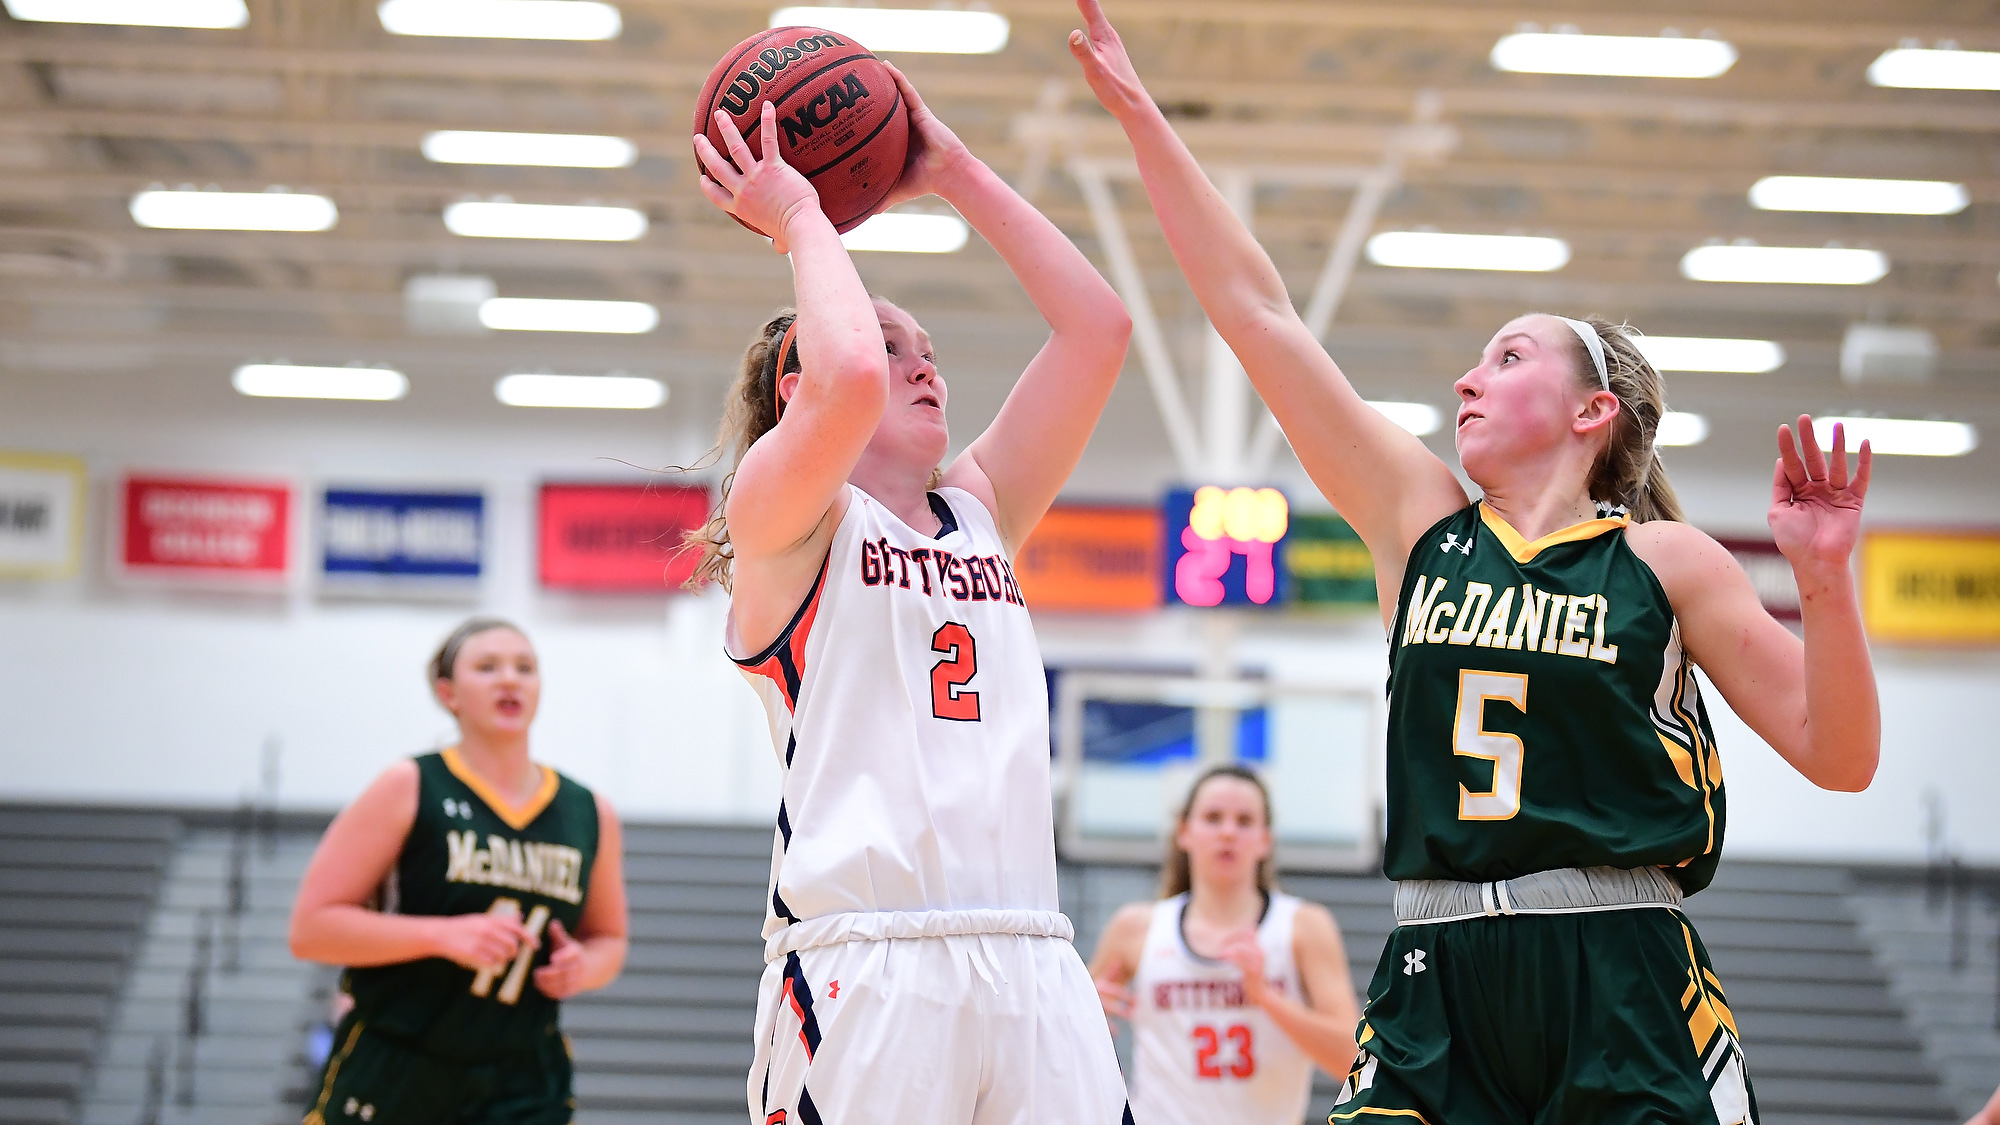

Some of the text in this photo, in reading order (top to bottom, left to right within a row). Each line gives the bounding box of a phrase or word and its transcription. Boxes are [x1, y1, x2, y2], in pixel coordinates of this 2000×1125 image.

[718, 33, 845, 117] Wilson
[779, 72, 870, 149] NCAA
[793, 130, 831, 156] OFFICIAL
[832, 112, 856, 130] GAME
[861, 537, 1024, 608] GETTYSBU
[1401, 574, 1619, 665] McDANIEL
[930, 620, 981, 722] 2
[1453, 668, 1529, 821] 5
[445, 829, 583, 905] McDANIEL
[1190, 1023, 1257, 1081] 23
